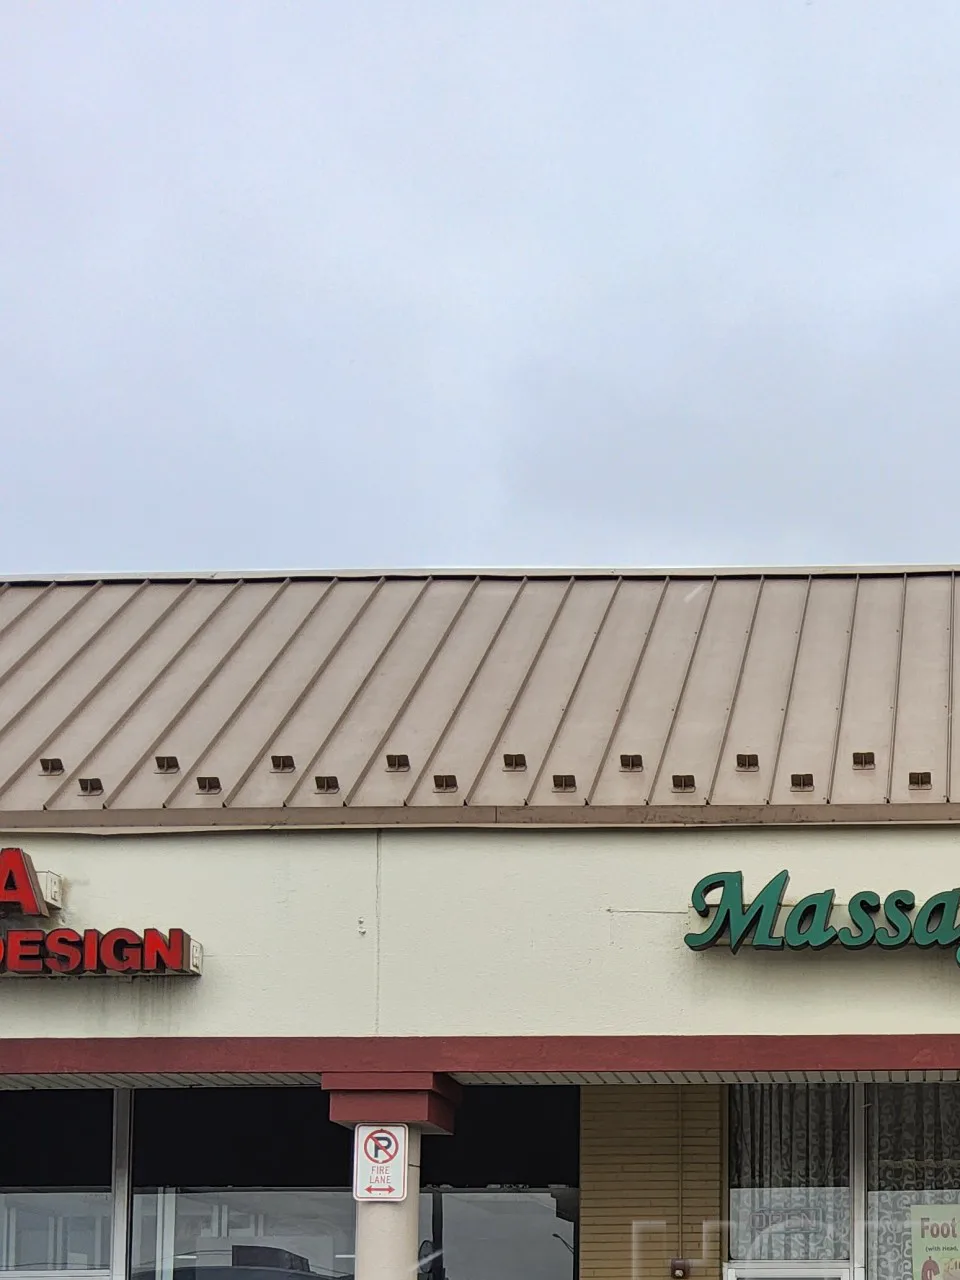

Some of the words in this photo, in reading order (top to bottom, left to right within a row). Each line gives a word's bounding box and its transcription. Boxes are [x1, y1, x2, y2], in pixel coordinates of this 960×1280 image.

[0, 927, 188, 974] ESIGN
[371, 1165, 391, 1174] FIRE
[369, 1175, 391, 1184] LANE
[920, 1217, 958, 1239] Foot
